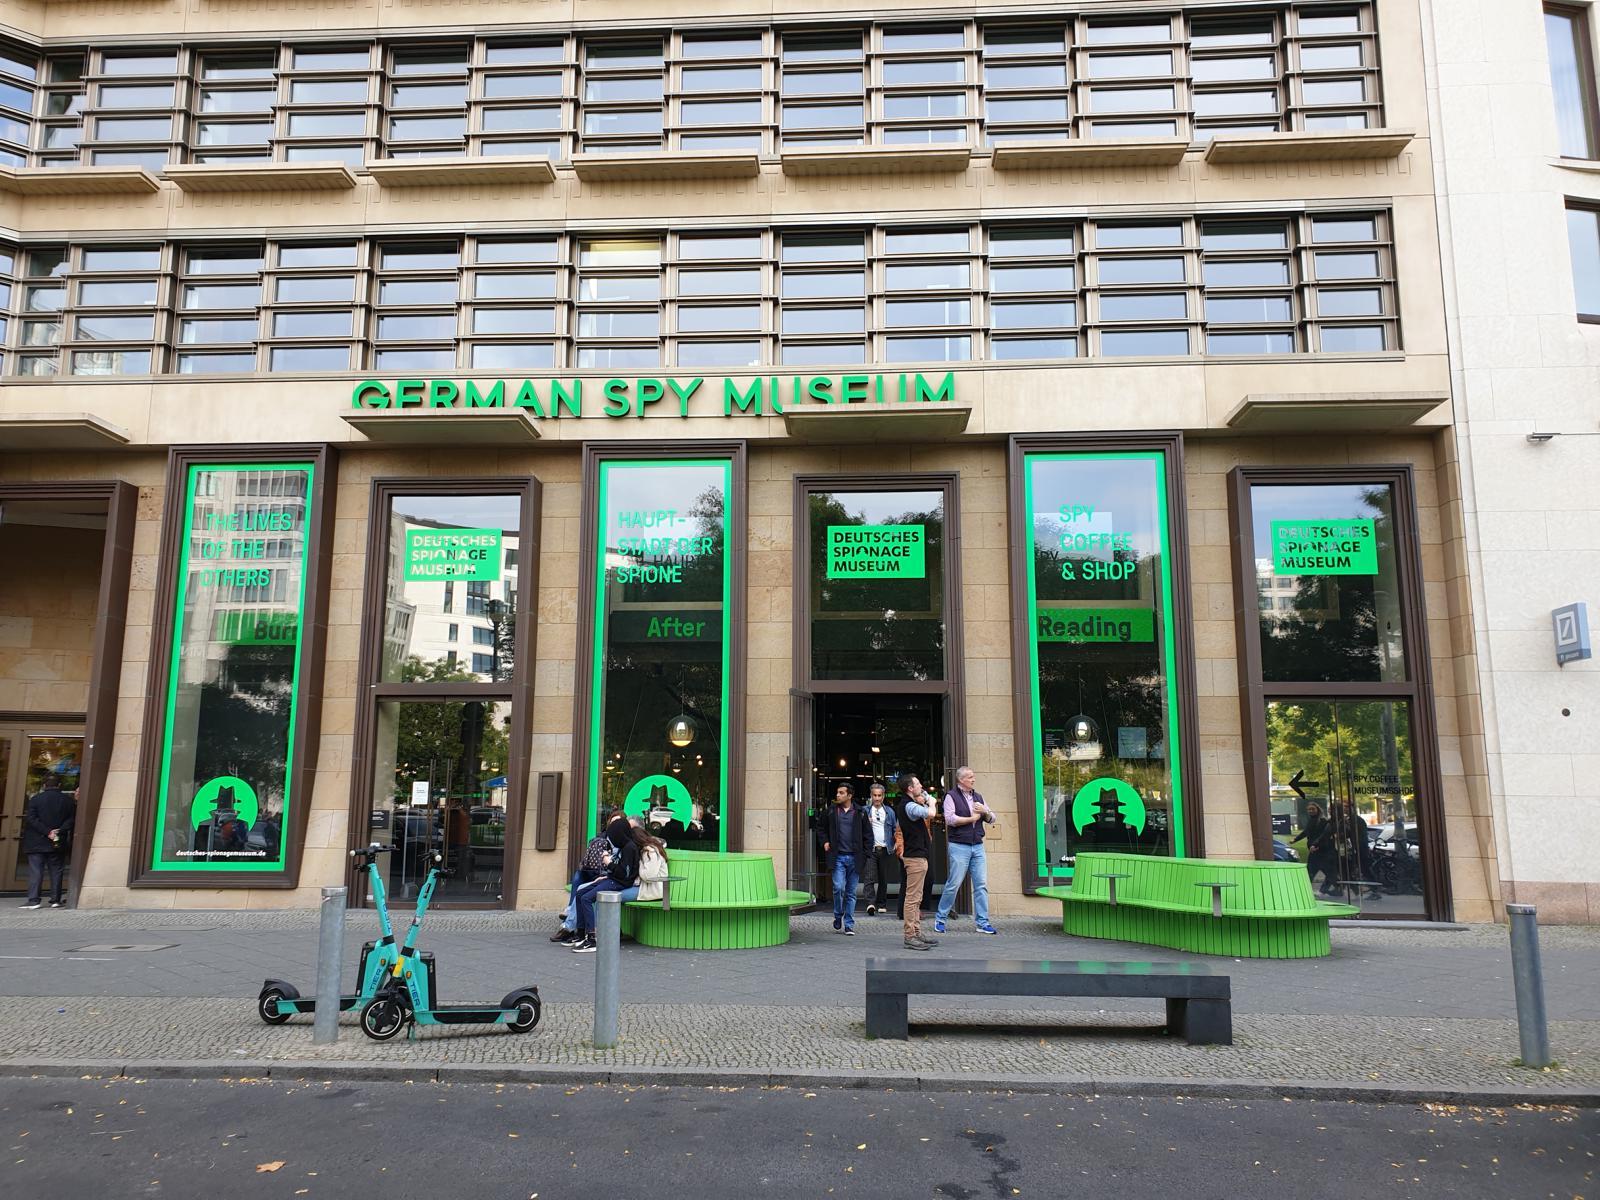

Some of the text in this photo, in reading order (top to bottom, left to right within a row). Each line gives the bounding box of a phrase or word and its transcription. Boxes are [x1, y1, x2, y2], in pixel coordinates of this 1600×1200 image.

[352, 372, 955, 417] GERMAN SPY MUSEUM
[206, 513, 291, 531] THE LIVES
[618, 510, 685, 528] HAUPT-
[1060, 504, 1095, 522] SPY
[412, 535, 497, 547] DEUTSCHES
[834, 531, 919, 543] DEUTSCHES
[1279, 526, 1369, 538] DEUTSCHES
[203, 541, 264, 559] OF THE
[617, 537, 713, 555] STADT DER
[1060, 532, 1133, 551] COFFEE
[411, 563, 476, 575] MUSEUM
[834, 560, 900, 572] MUSEUM
[1061, 562, 1135, 580] & SHOP
[1282, 556, 1351, 568] MUSEUM
[200, 569, 270, 587] OTHERS
[617, 565, 682, 584] SPIONE
[647, 616, 706, 637] After
[1038, 615, 1131, 641] Reading
[369, 968, 382, 991] TIER
[410, 981, 421, 1006] TIER
